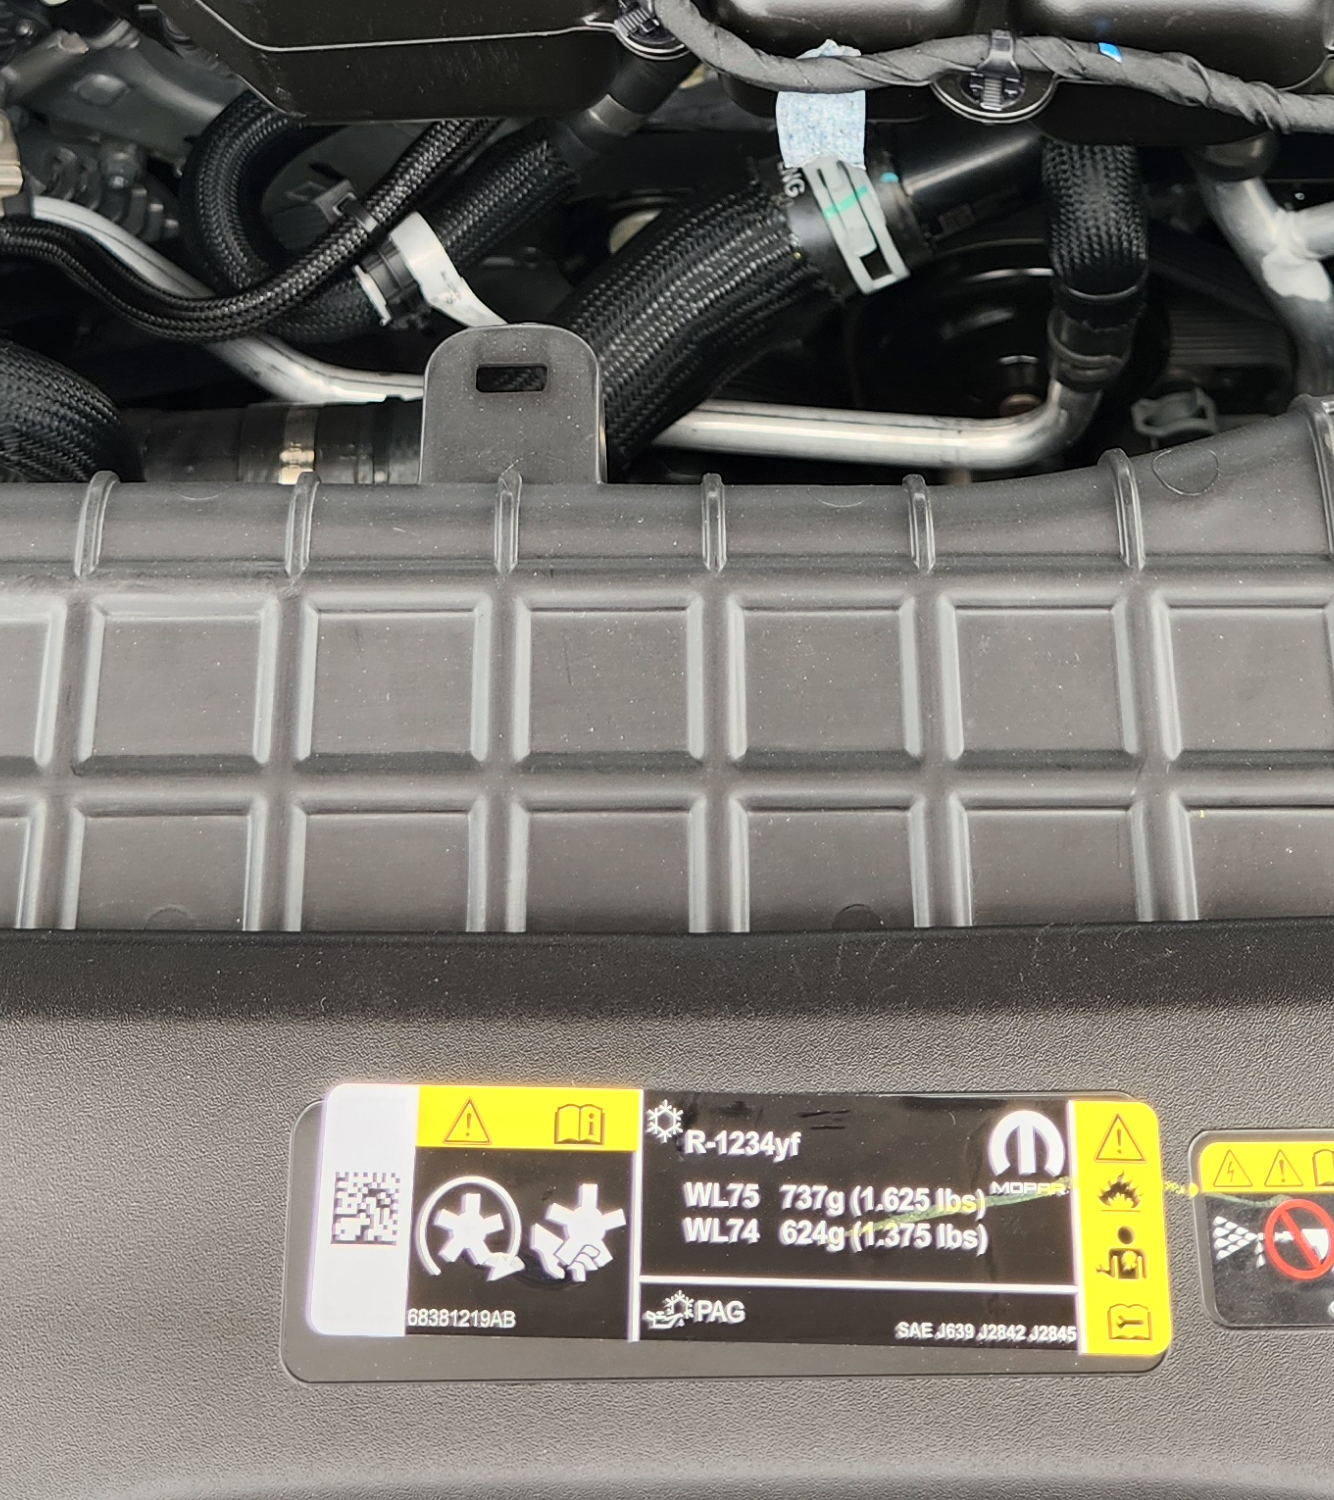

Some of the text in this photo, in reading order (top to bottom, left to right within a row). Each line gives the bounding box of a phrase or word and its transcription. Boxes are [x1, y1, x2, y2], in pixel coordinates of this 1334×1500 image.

[684, 1129, 802, 1162] R-1234yf
[682, 1182, 987, 1221] WL75 737g (1.625 lbs)
[682, 1217, 989, 1257] WL74 624g (1.375 lbs)
[407, 1308, 516, 1329] 68381219AB
[693, 1299, 746, 1323] PAG
[895, 1321, 1077, 1343] SAE J639 J2842 J2845
